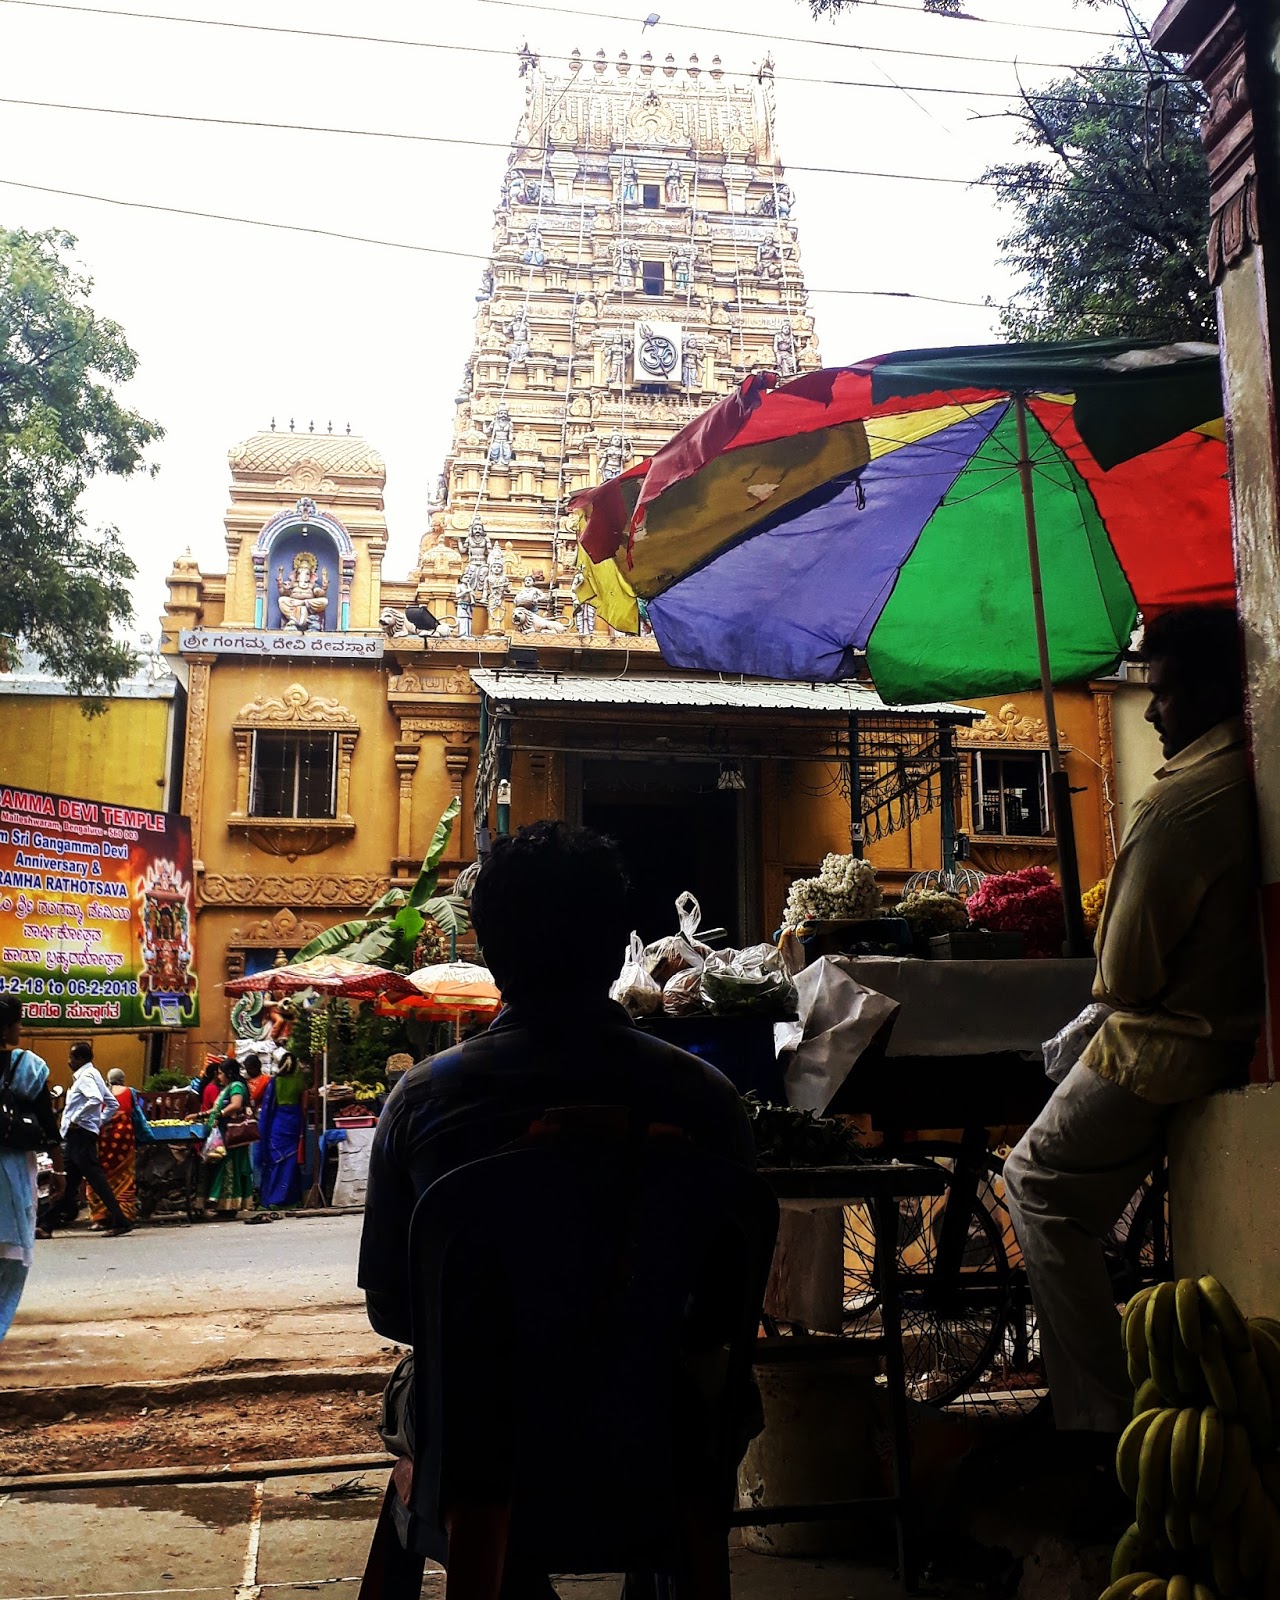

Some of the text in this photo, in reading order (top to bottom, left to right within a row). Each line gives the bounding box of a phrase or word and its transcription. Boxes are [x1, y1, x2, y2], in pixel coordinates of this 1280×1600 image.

[184, 634, 376, 655] ಶ್ರೀ ಗಂಗಮ್ಮ ದೇವಿ ದೇವಸ್ಥಾನ
[0, 789, 165, 831] AMMA DEVI TEMPLE
[12, 829, 29, 846] Sri
[33, 833, 99, 855] Gangamma
[104, 844, 128, 859] Devi
[15, 852, 101, 876] Anniversary &
[46, 876, 128, 898] RATHOTSAVA
[49, 980, 63, 994] to
[68, 981, 137, 996] 06-2-2018
